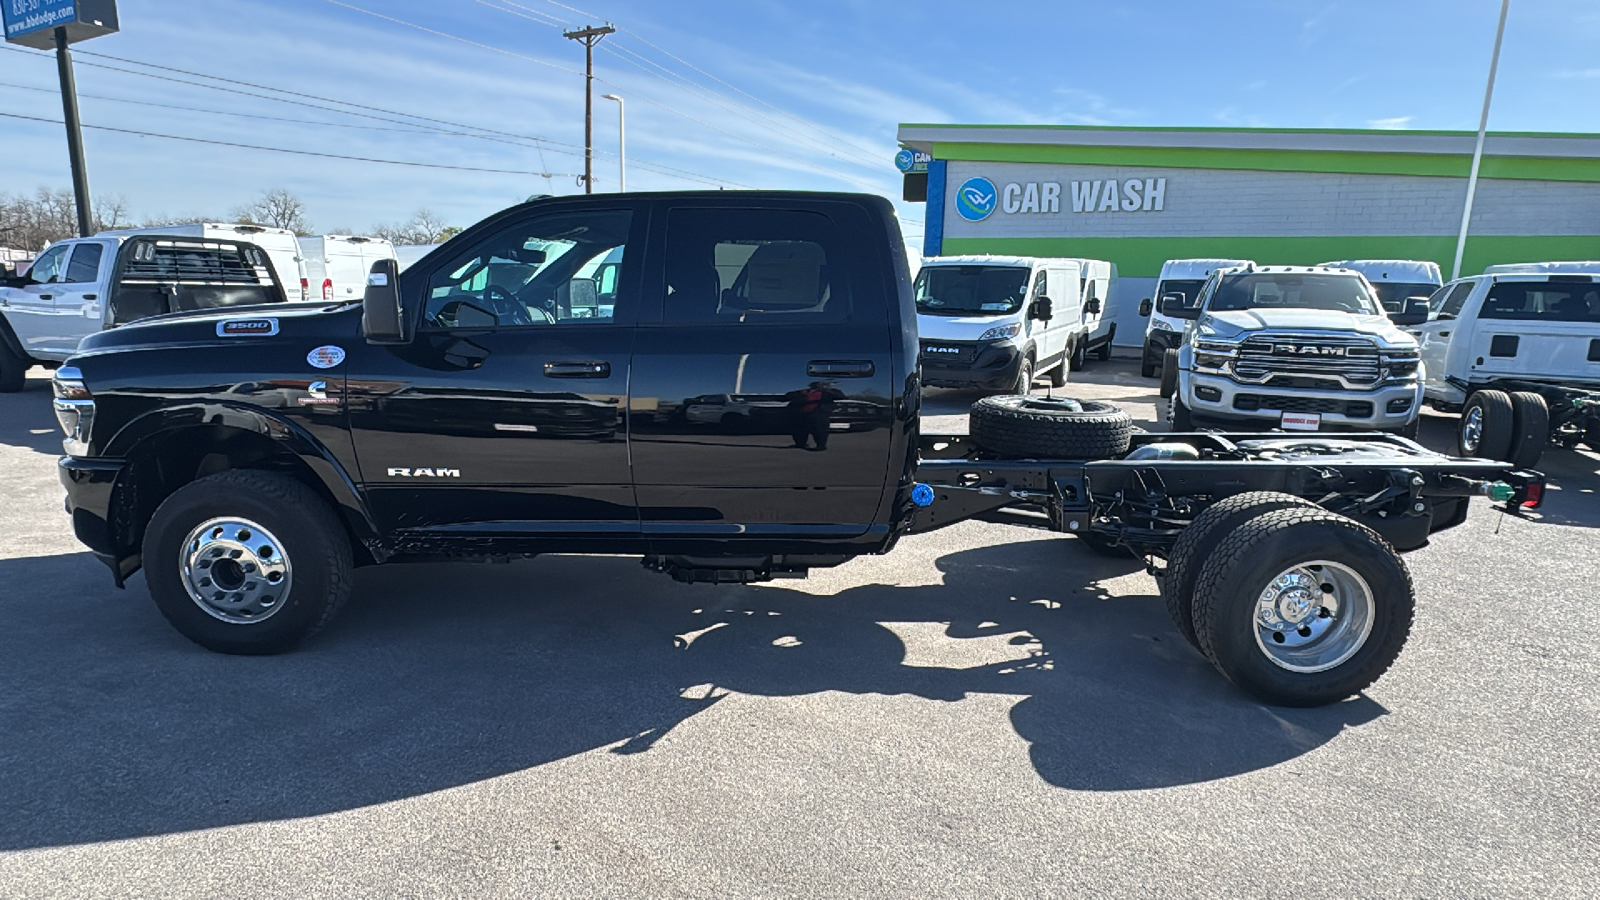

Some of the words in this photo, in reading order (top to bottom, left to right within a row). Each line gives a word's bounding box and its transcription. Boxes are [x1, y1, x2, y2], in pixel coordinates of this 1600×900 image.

[8, 6, 74, 33] www.bbdodge.com
[1002, 182, 1061, 214] CAR
[1071, 178, 1166, 213] WASH
[926, 346, 959, 354] RAM
[1275, 344, 1344, 356] RAM
[387, 467, 461, 478] RAM
